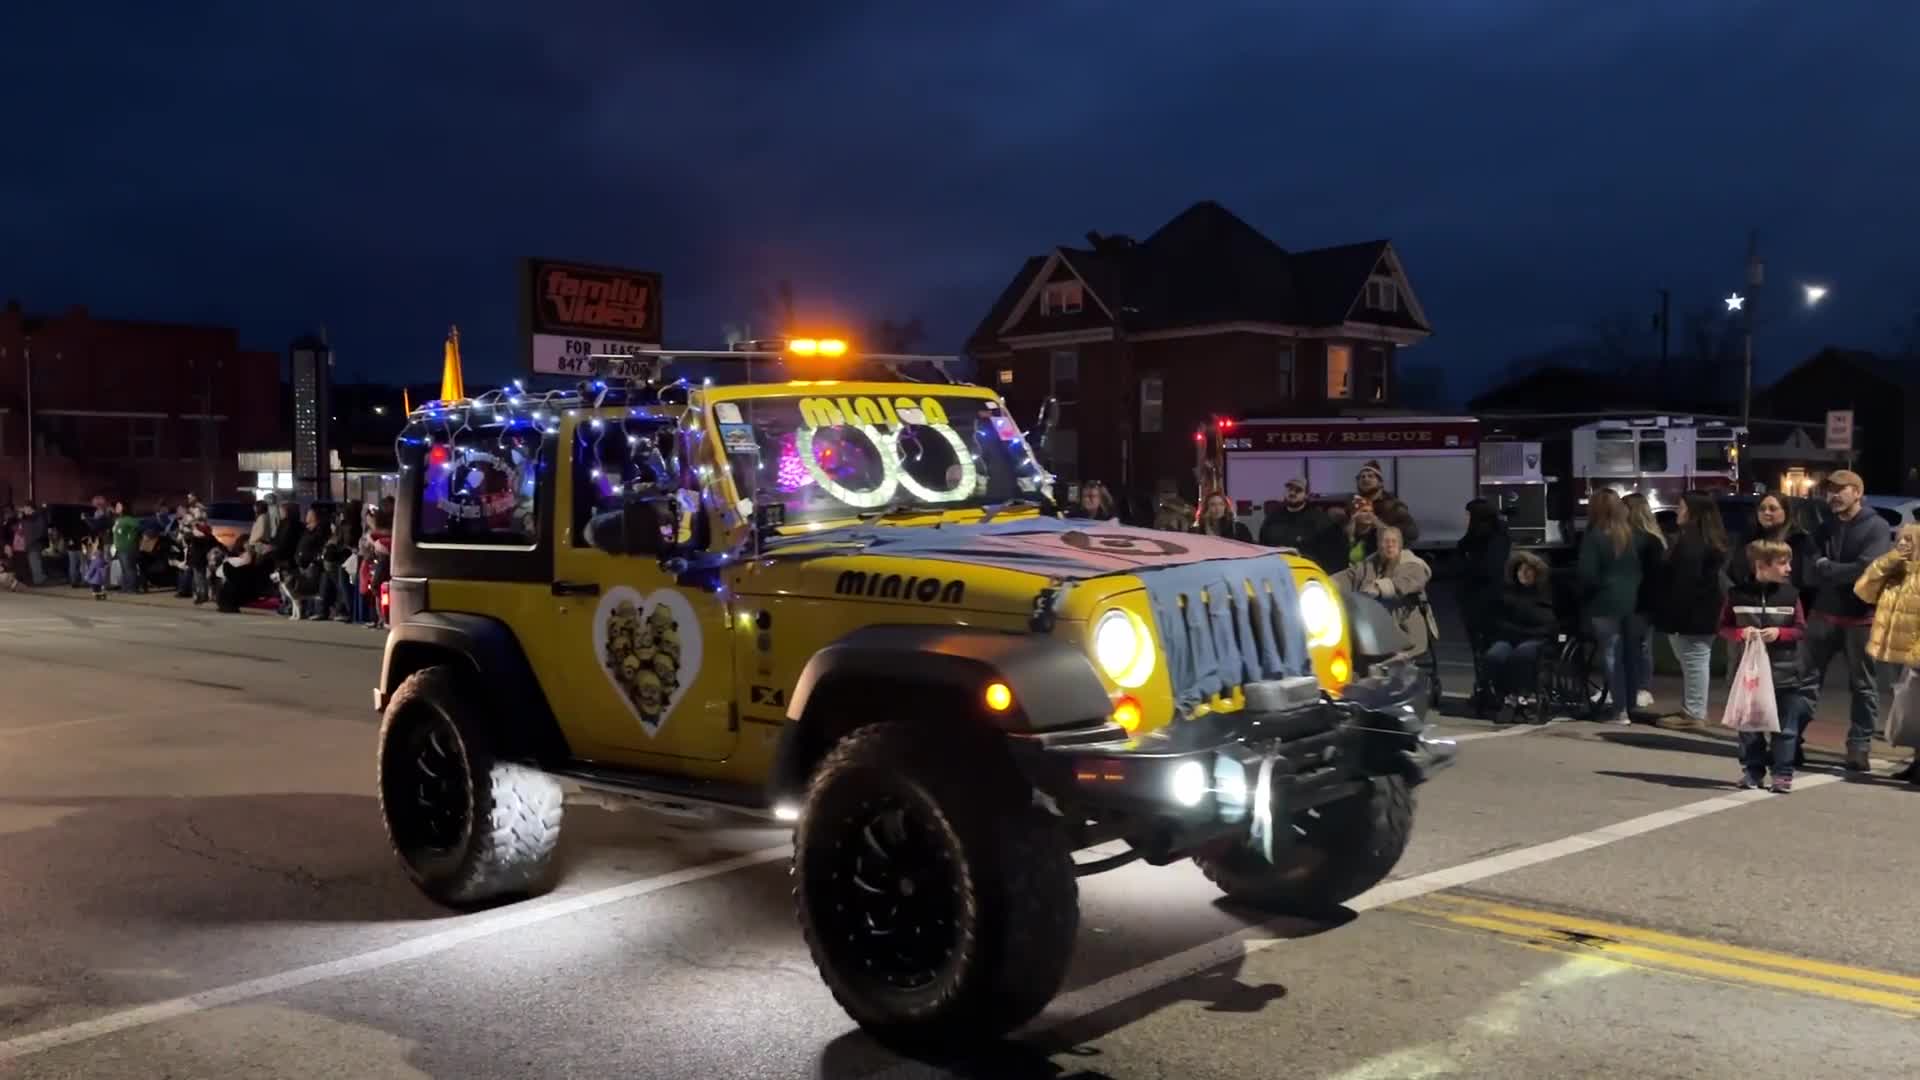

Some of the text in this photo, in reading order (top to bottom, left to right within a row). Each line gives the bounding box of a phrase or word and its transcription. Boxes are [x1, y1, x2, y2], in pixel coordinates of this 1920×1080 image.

[566, 340, 591, 354] FOR
[1266, 432, 1319, 443] FIRE
[1343, 431, 1432, 442] RESCUE
